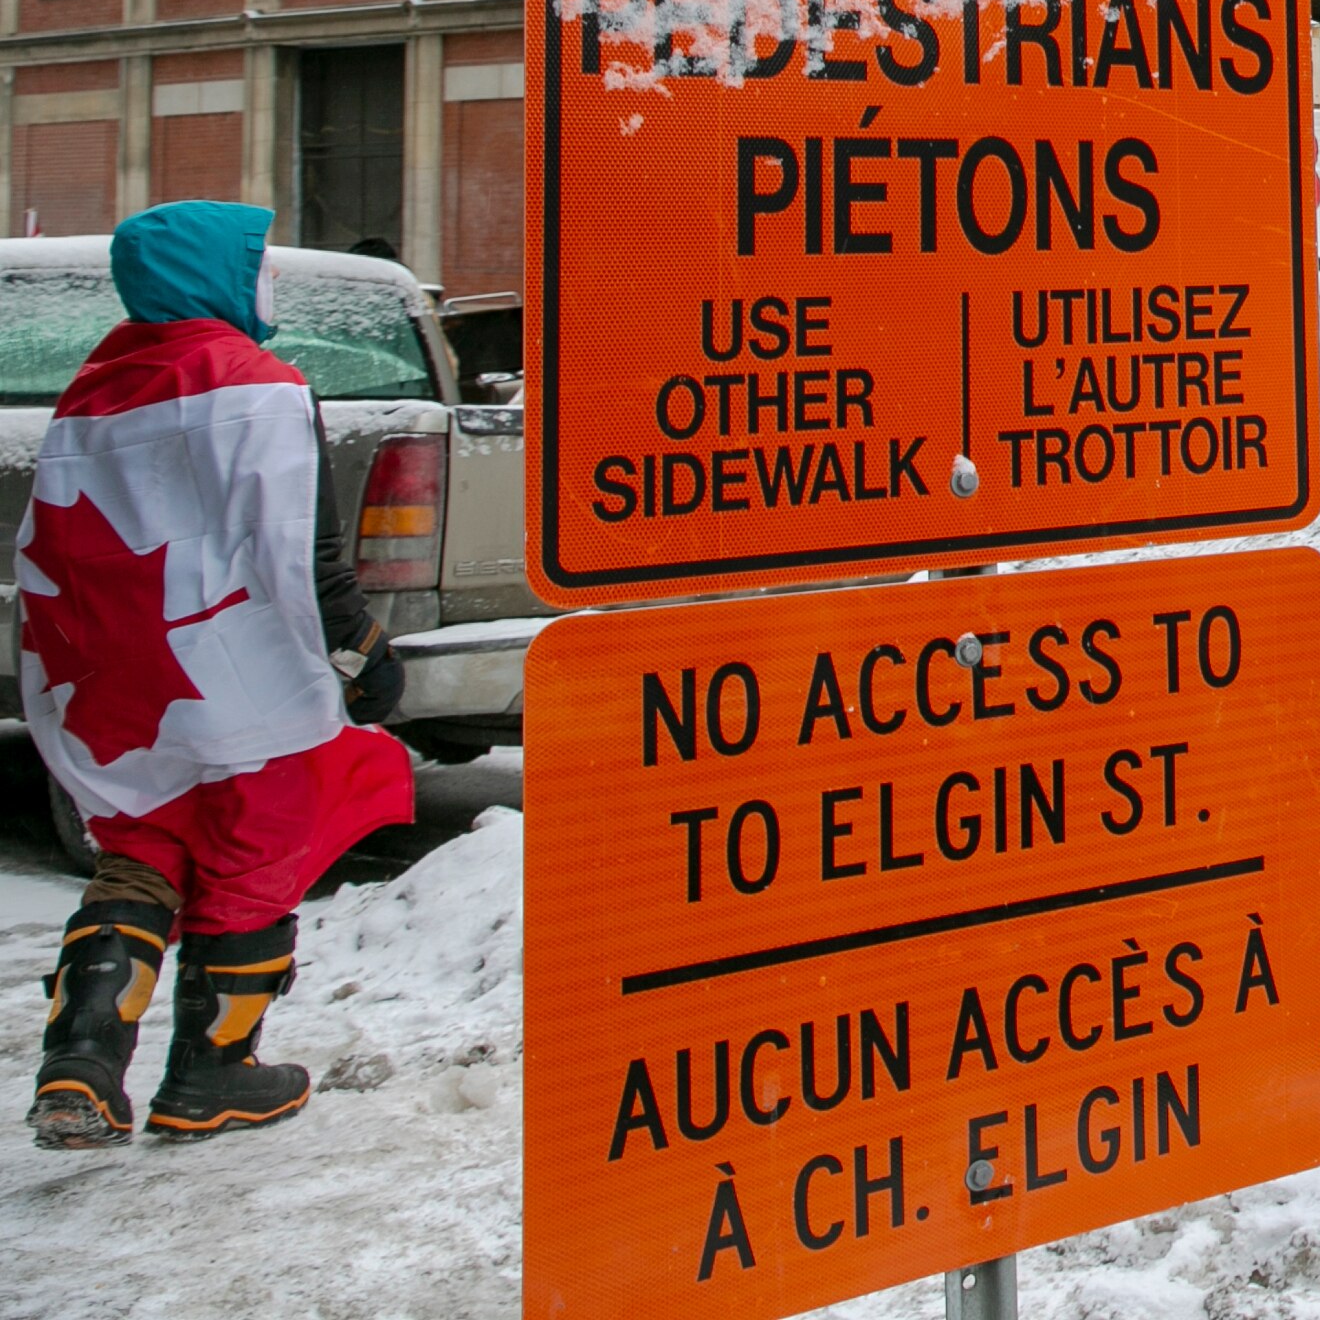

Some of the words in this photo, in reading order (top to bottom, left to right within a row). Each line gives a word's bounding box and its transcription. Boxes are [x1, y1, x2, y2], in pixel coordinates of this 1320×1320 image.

[736, 105, 1160, 257] PIÉTONS
[701, 296, 832, 363] USE
[1012, 284, 1250, 349] UTILISEZ
[655, 368, 874, 441] OTHER
[1023, 350, 1243, 417] L'AUTRE
[591, 435, 929, 523] SIDEWALK
[997, 413, 1267, 488] TROTTOIR
[642, 661, 760, 768] NO
[797, 618, 1122, 746] ACCESS
[1153, 604, 1241, 694] TO
[670, 799, 780, 904] TO
[821, 758, 1065, 882] ELGIN
[1101, 741, 1210, 837] ST.
[607, 1002, 911, 1164] AUCUN
[946, 936, 1205, 1080] ACCÈS
[1235, 912, 1279, 1014] À
[697, 1162, 756, 1283] À
[792, 1135, 930, 1251] CH.
[967, 1064, 1201, 1206] ELGIN
